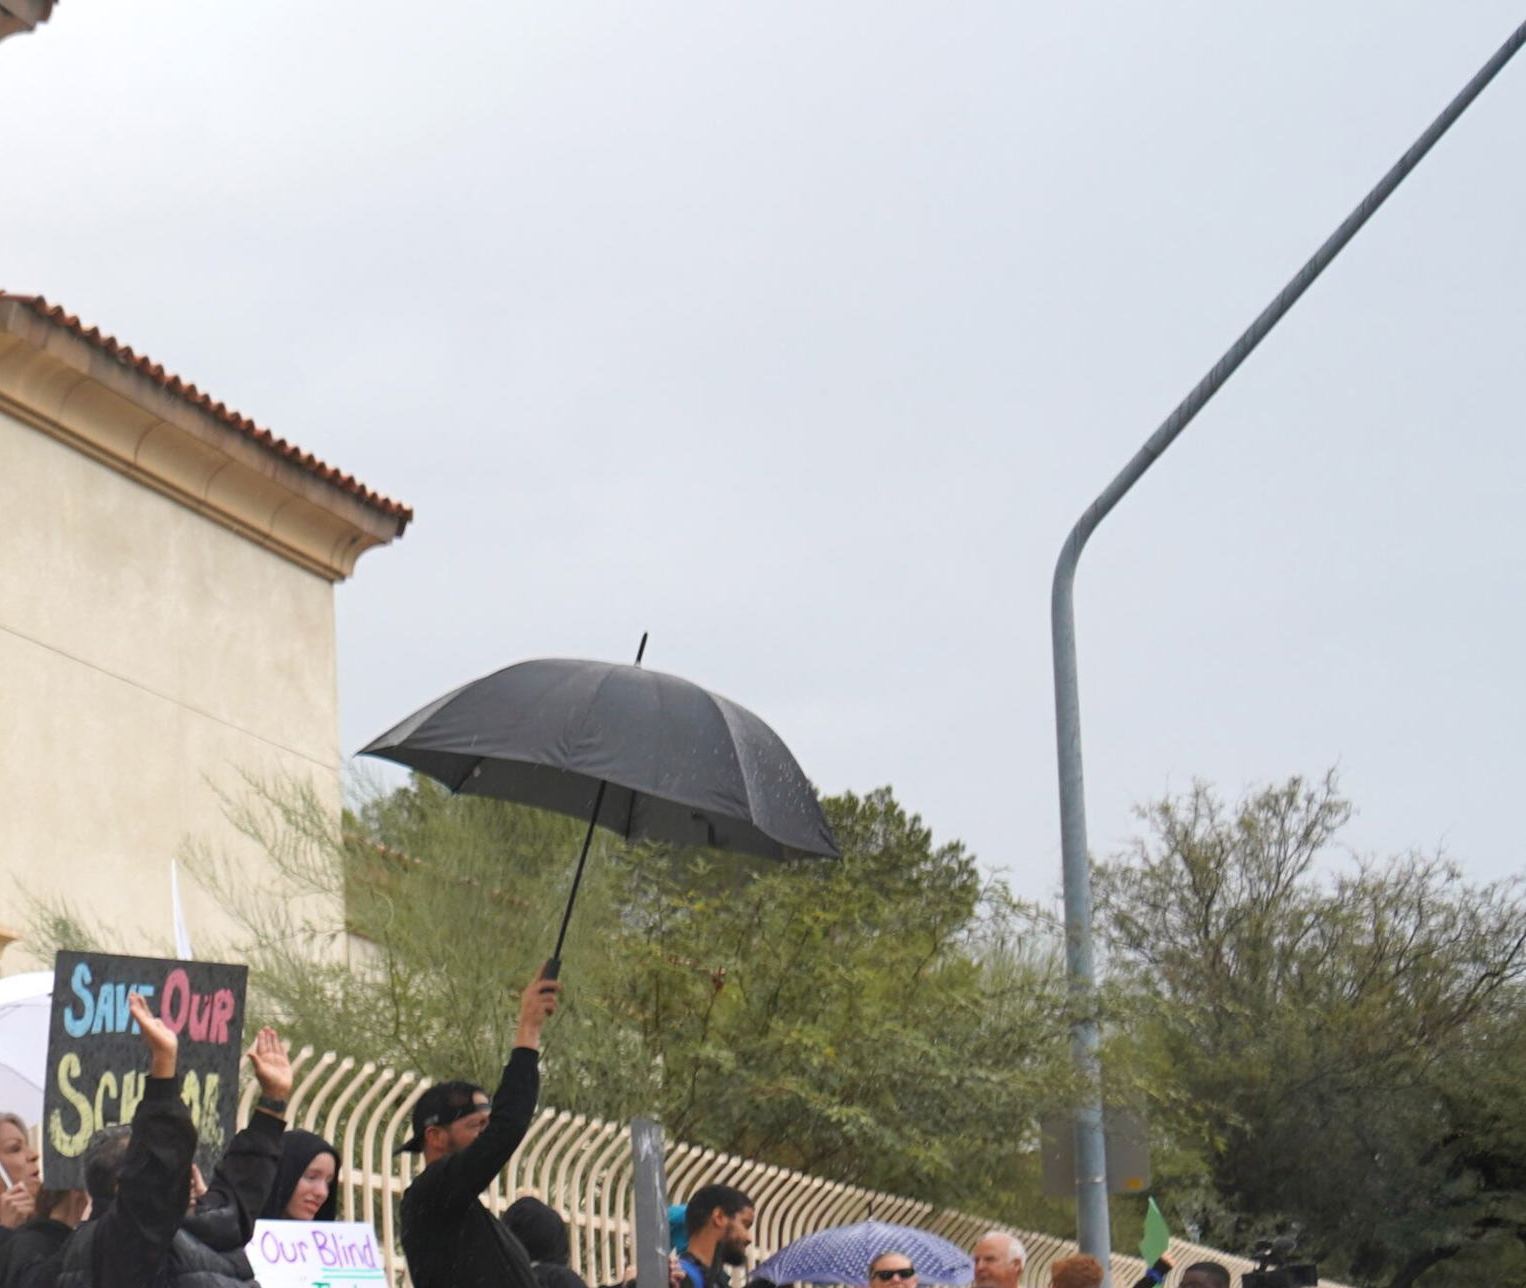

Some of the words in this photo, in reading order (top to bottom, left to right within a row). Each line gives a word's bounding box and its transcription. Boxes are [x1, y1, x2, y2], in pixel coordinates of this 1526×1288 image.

[49, 1051, 226, 1159] SCHOL
[260, 1230, 308, 1264] Our
[310, 1230, 377, 1269] Blind
